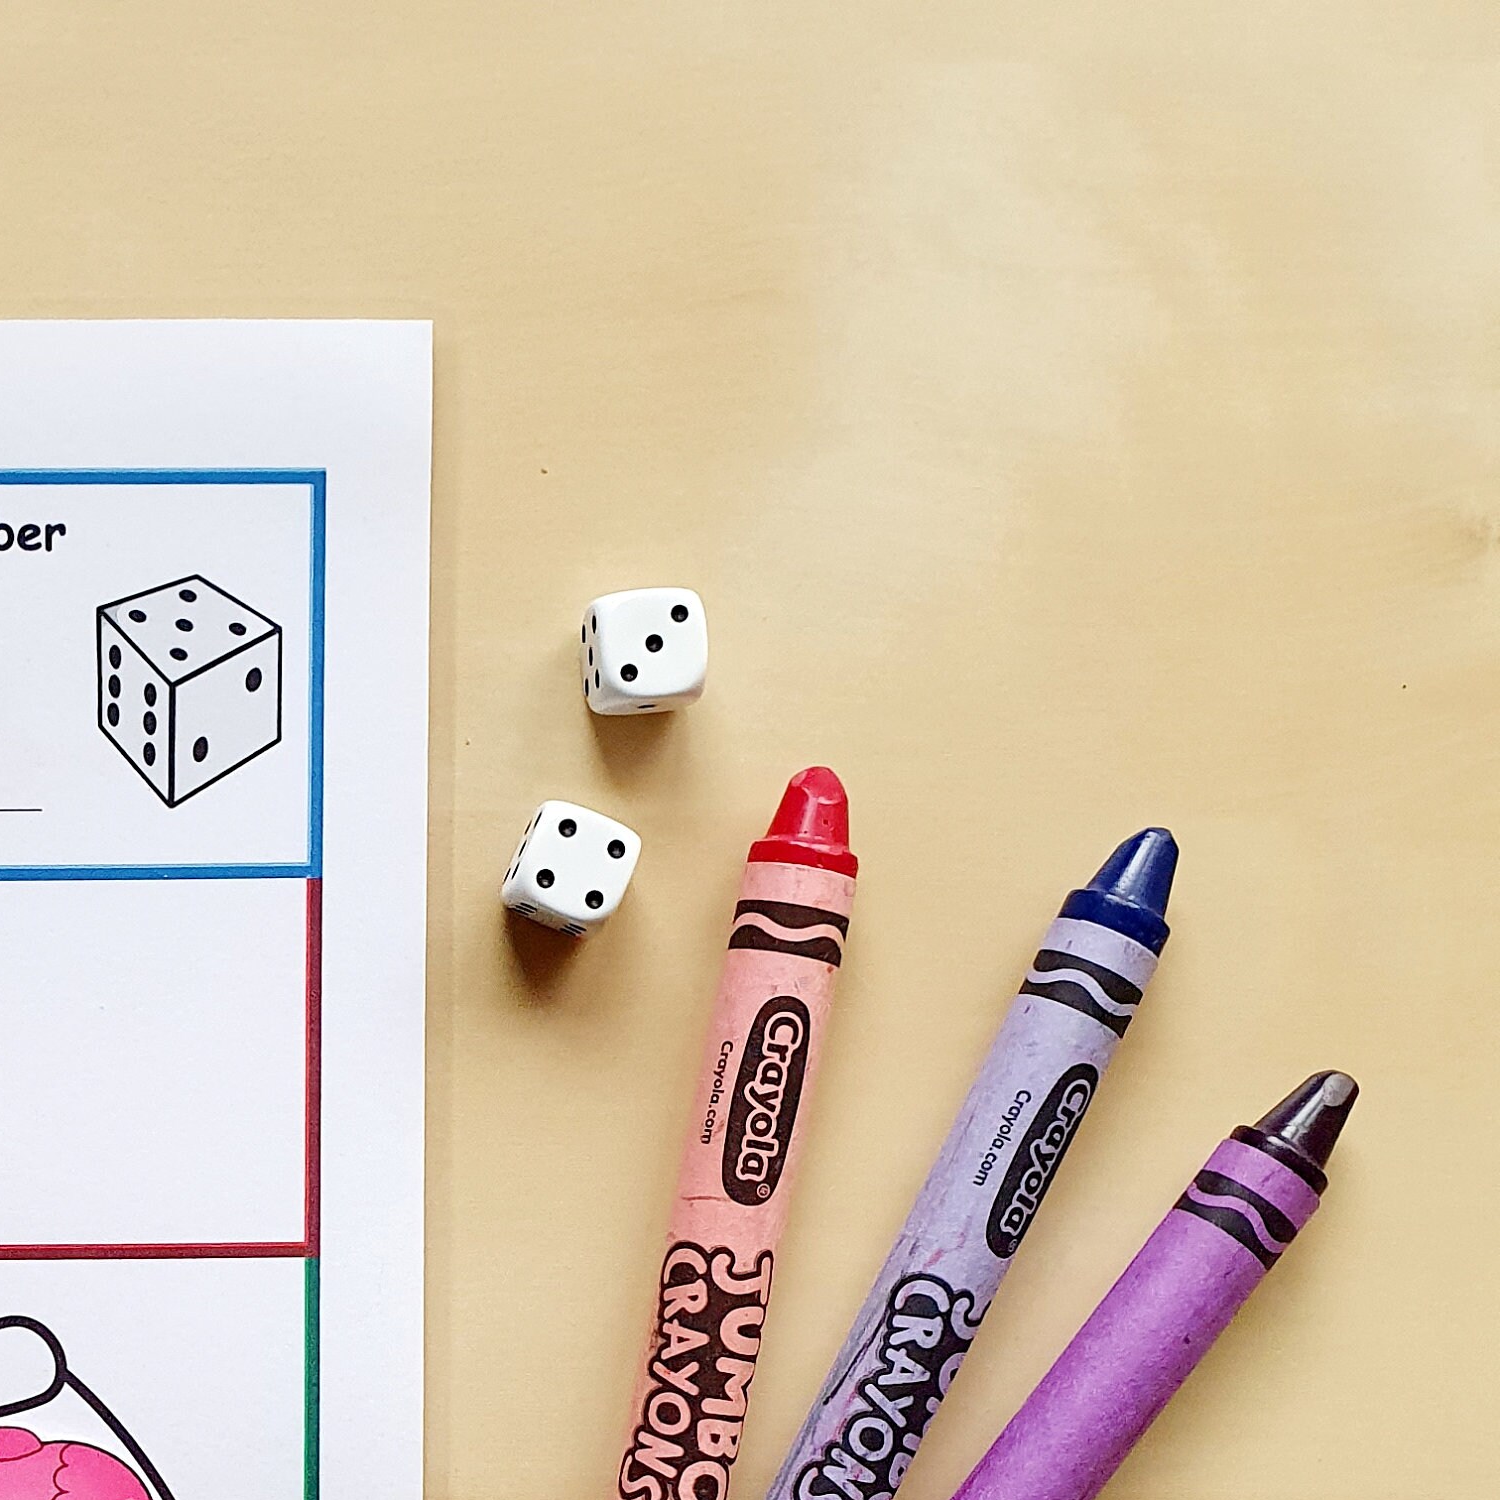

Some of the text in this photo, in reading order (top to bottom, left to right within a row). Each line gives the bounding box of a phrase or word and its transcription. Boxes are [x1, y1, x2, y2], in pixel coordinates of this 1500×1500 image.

[700, 1040, 734, 1145] Crayola.com
[736, 1012, 803, 1181] Crayola
[973, 1089, 1032, 1186] Crayola.com
